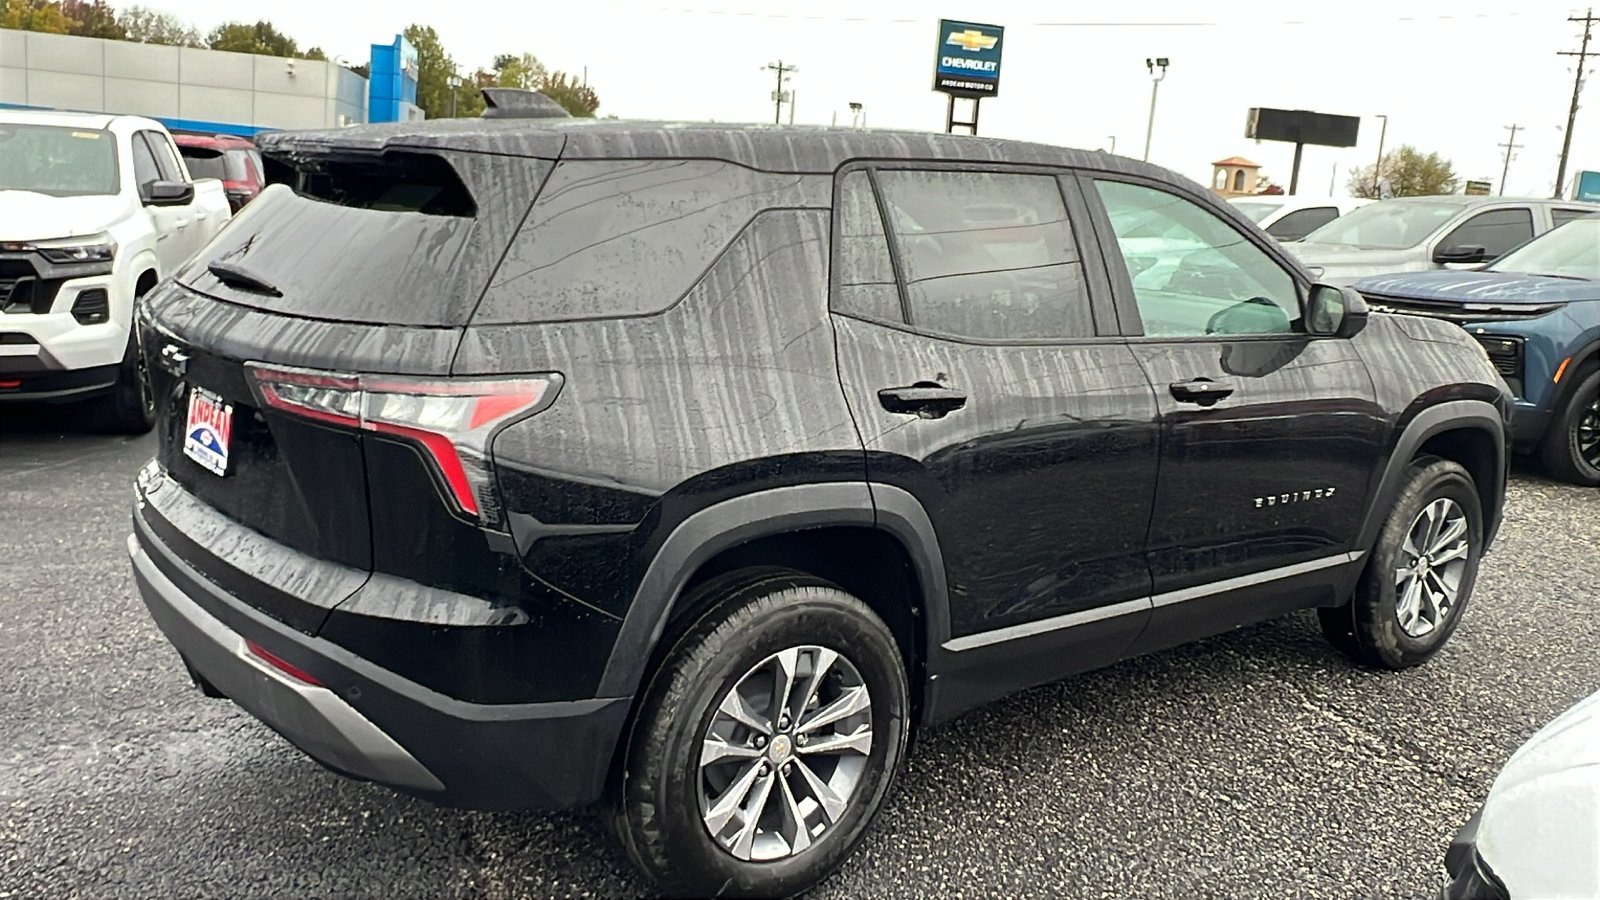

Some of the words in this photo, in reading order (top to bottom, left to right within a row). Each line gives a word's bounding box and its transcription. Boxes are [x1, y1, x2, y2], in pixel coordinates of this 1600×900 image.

[942, 56, 997, 71] CHEVROLET
[965, 82, 984, 90] MOTOR
[189, 393, 231, 450] ANDEAN
[1254, 487, 1336, 508] EQUINOX
